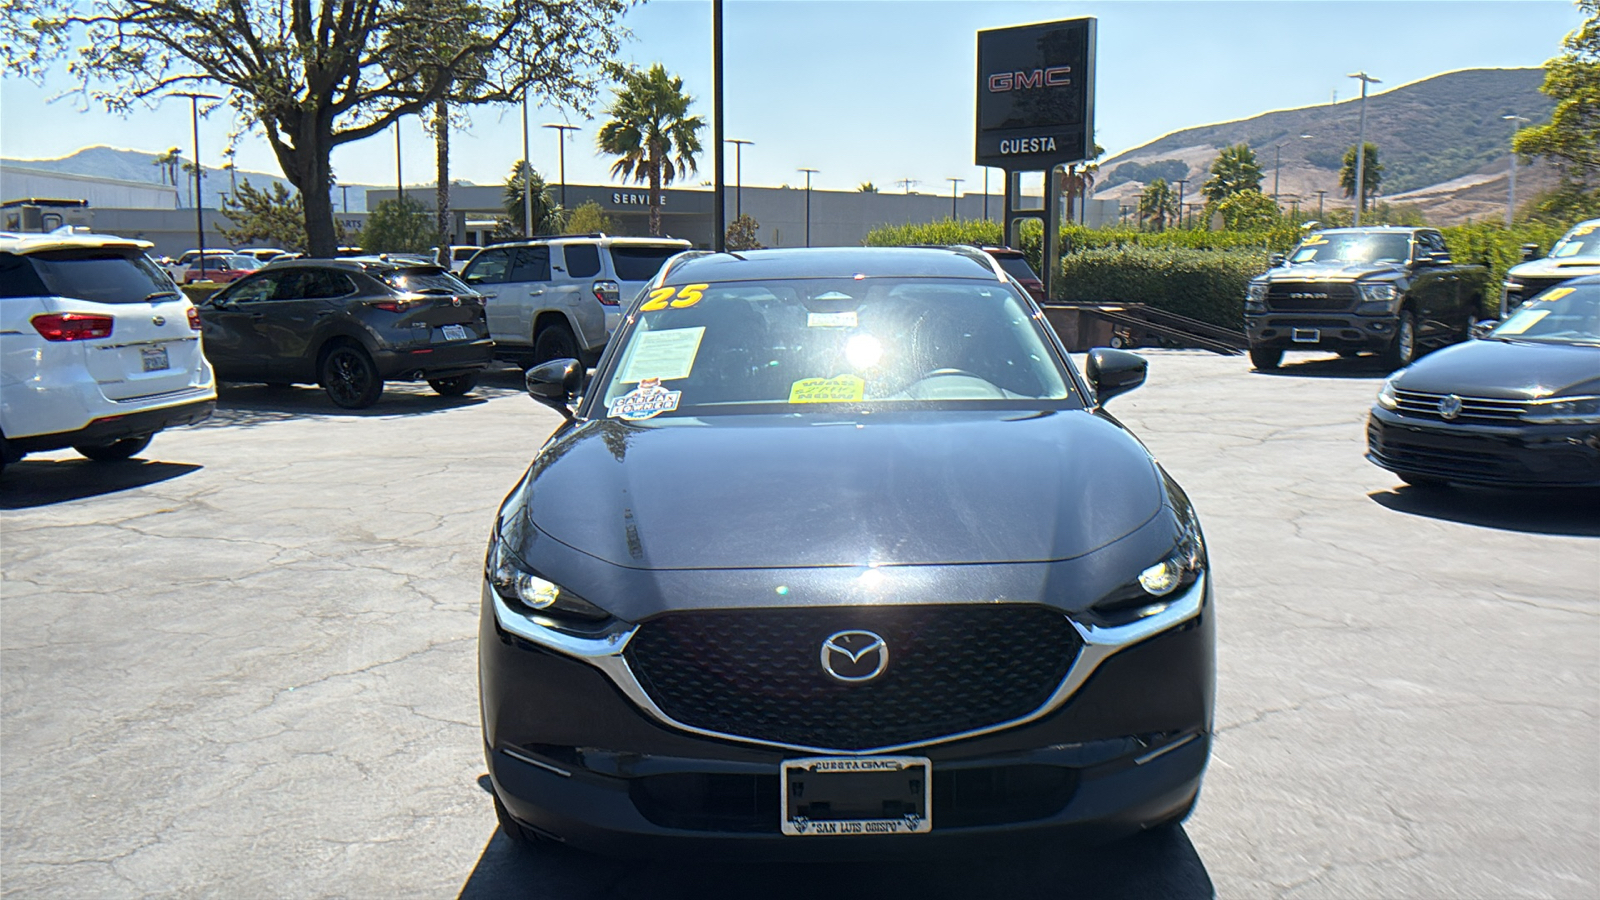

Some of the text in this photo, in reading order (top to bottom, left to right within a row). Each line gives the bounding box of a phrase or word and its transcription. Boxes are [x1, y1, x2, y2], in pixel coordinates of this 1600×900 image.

[988, 66, 1071, 92] GMC
[1000, 137, 1057, 154] CUESTA
[613, 193, 667, 205] SERVIE
[640, 283, 709, 312] 25
[816, 761, 897, 770] CUESTA GMC
[840, 822, 862, 833] LUIS
